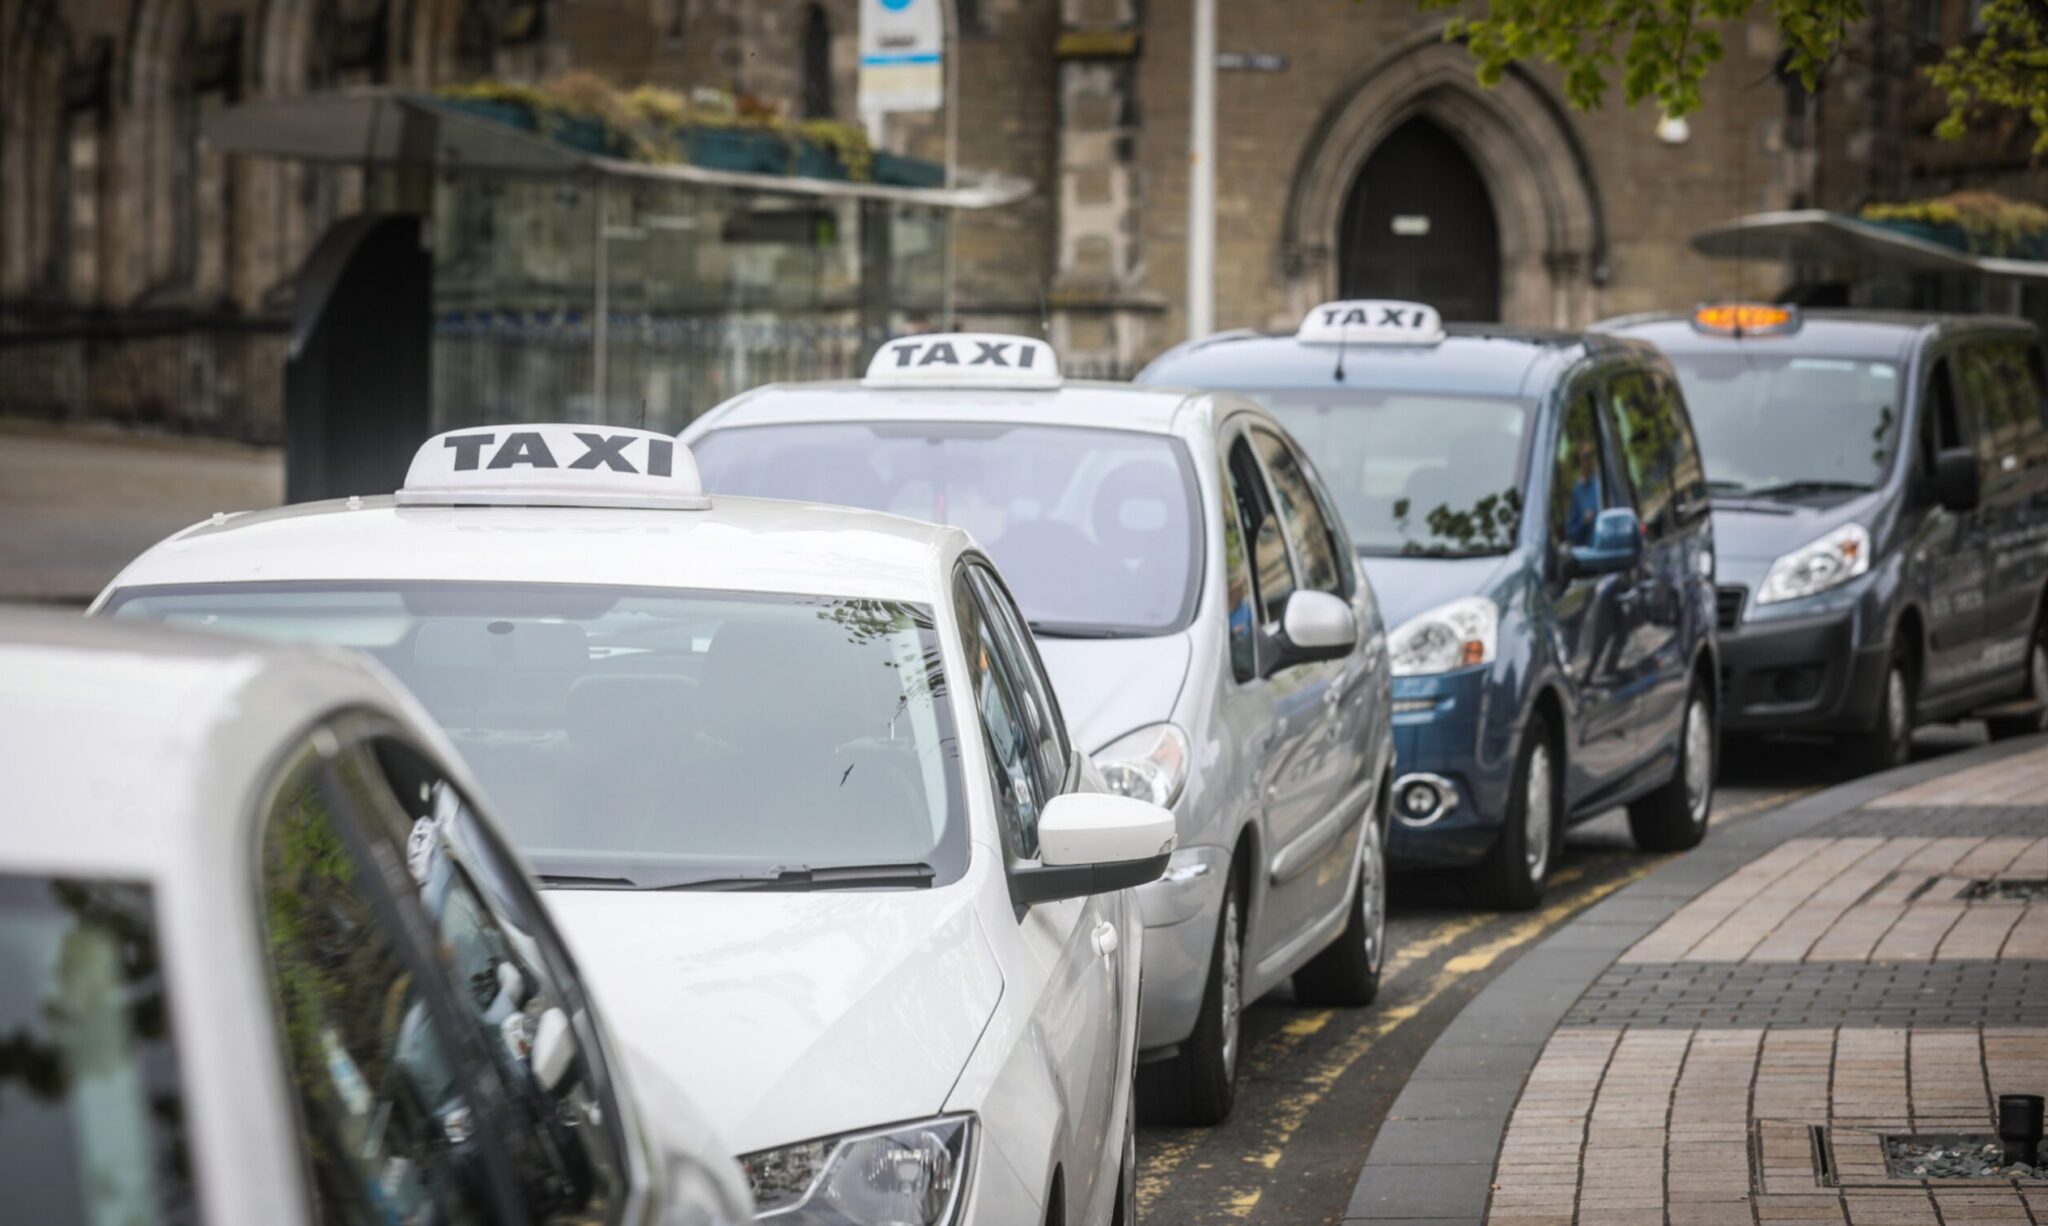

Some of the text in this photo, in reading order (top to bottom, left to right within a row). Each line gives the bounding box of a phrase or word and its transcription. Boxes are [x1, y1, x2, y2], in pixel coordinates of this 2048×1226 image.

[1324, 307, 1425, 329] TAXI
[891, 341, 1036, 369] TAXI
[443, 431, 674, 478] TAXI
